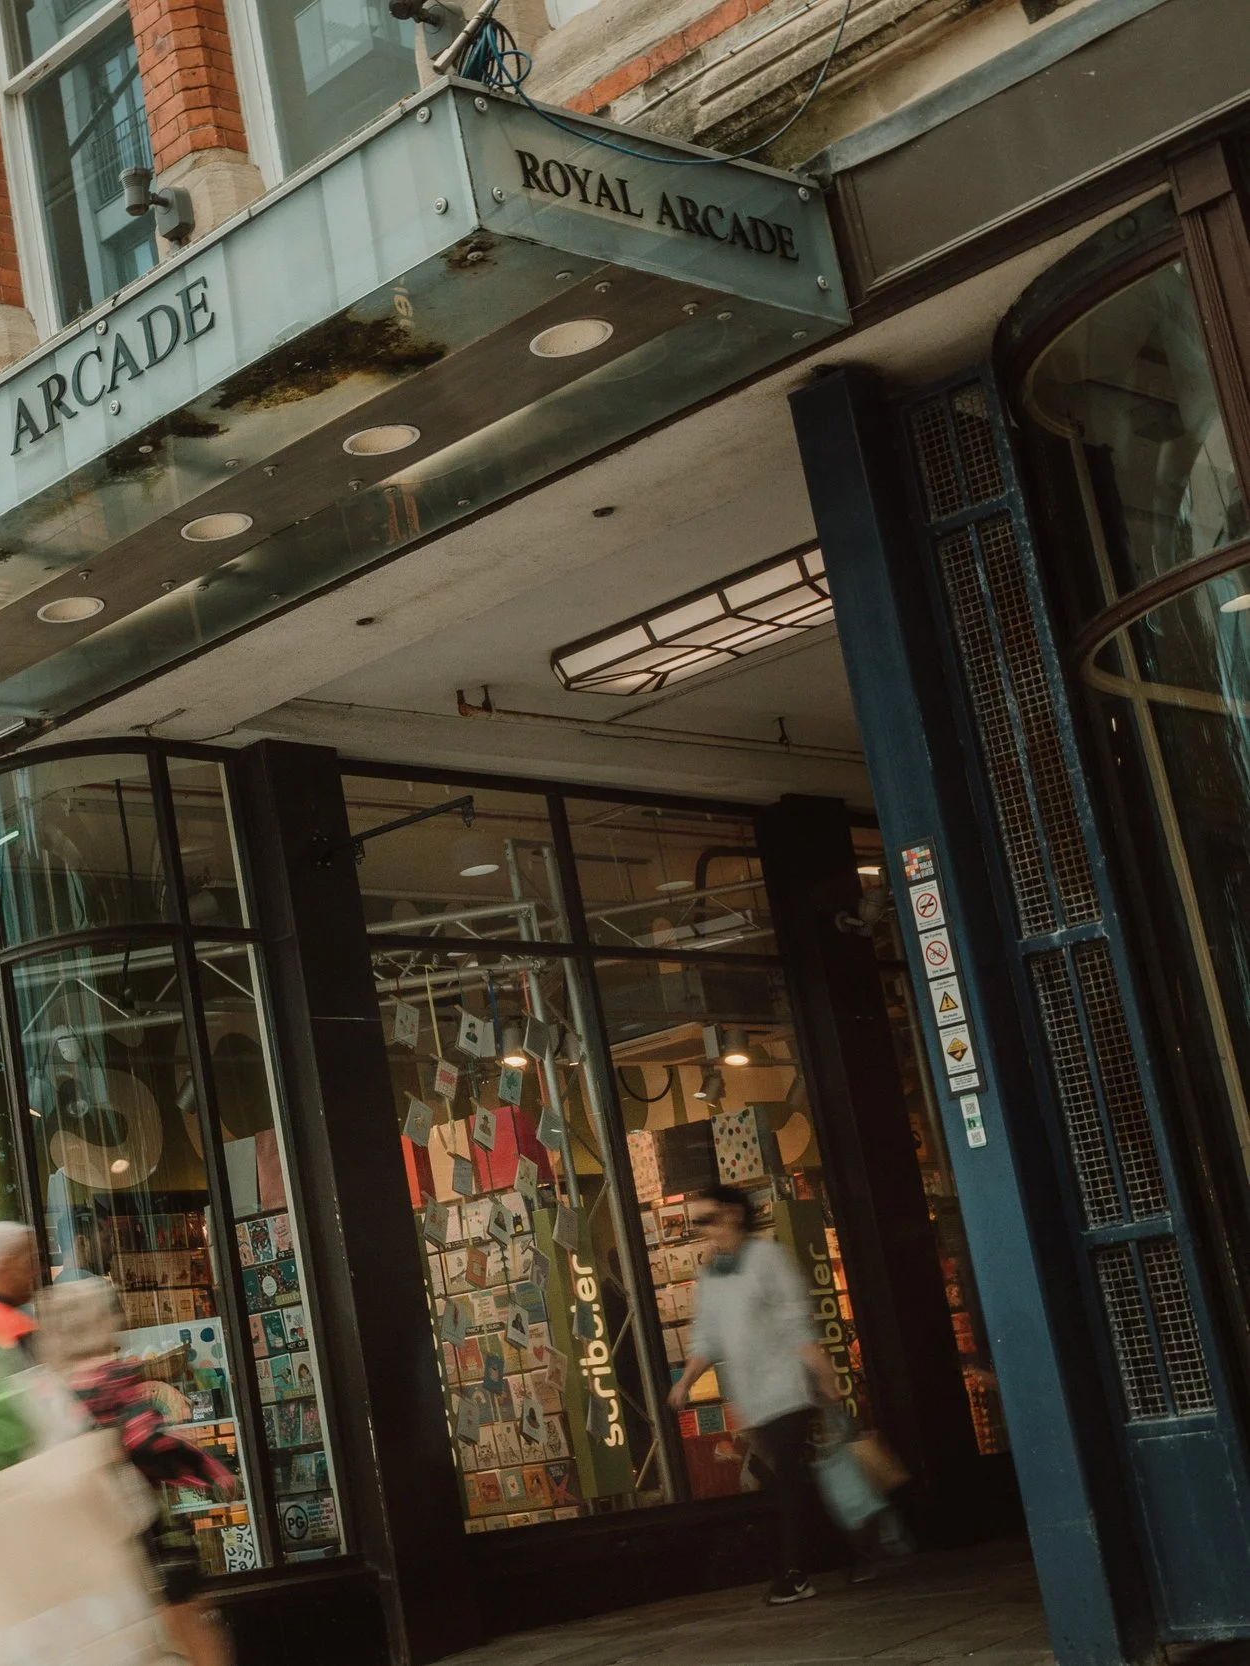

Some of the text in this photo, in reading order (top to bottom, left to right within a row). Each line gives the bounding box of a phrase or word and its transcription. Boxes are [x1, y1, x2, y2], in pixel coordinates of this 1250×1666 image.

[514, 149, 800, 263] ROYAL ARCADE
[10, 276, 217, 456] ARCADE
[287, 1515, 305, 1530] PG
